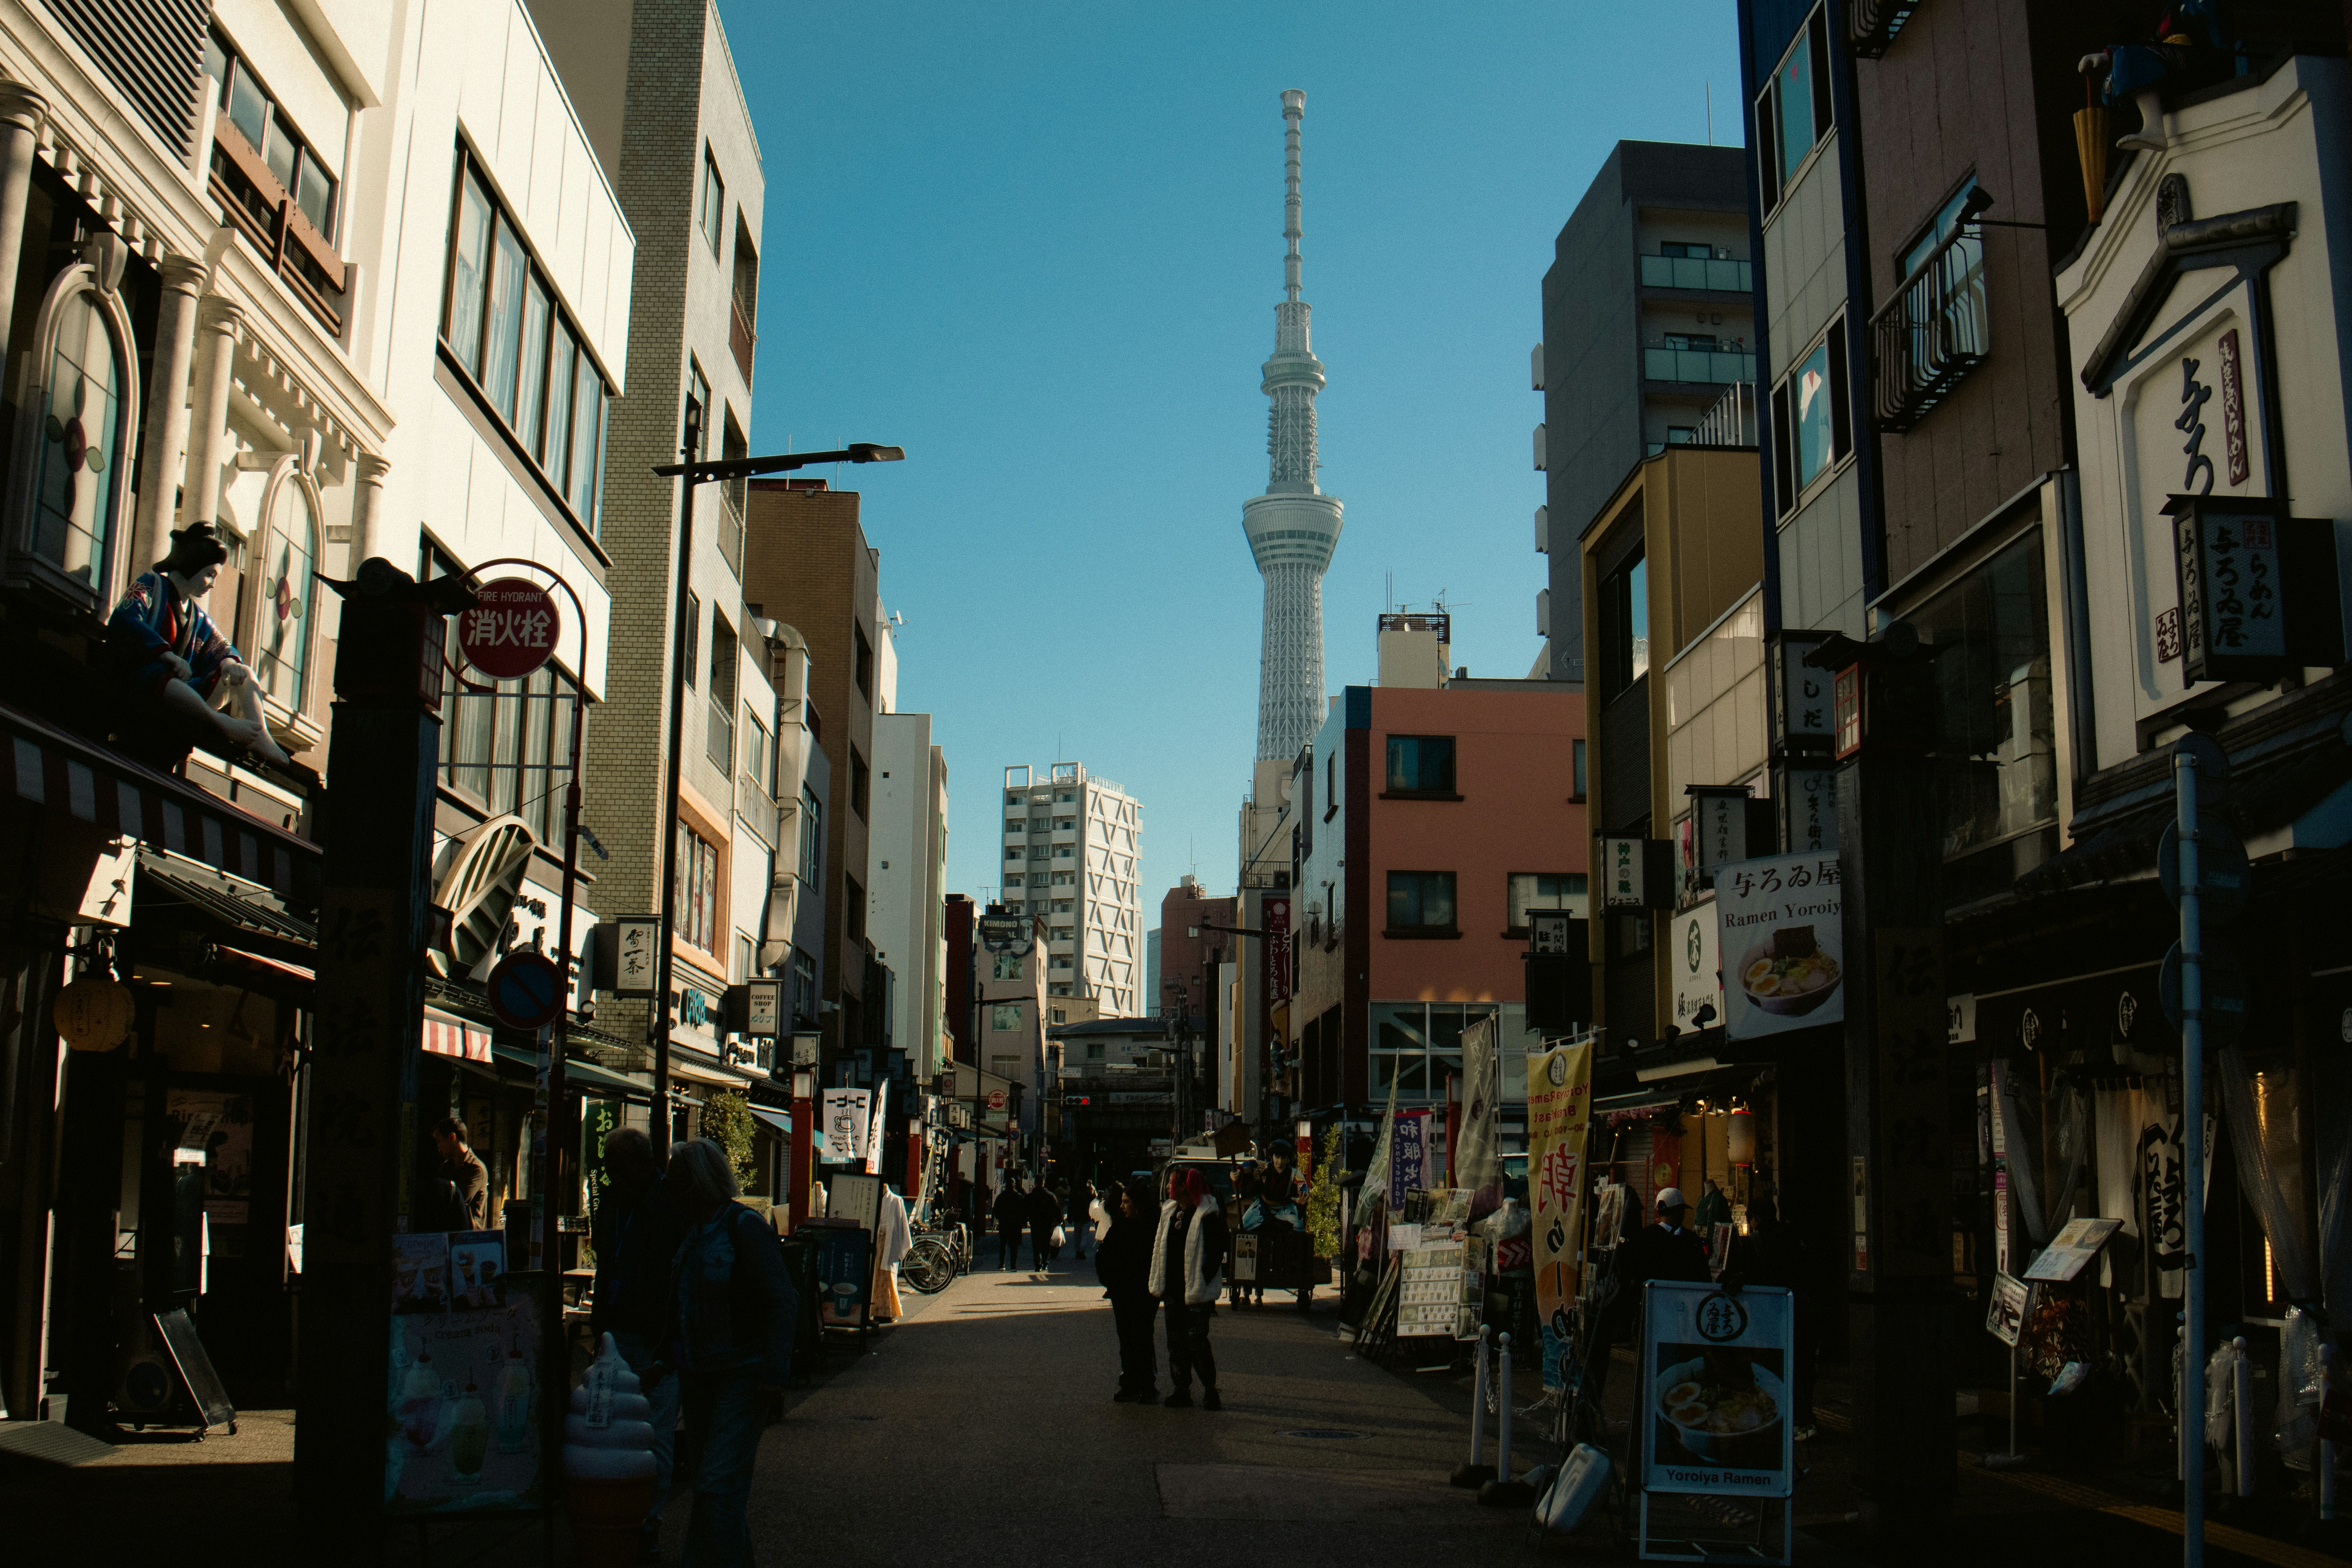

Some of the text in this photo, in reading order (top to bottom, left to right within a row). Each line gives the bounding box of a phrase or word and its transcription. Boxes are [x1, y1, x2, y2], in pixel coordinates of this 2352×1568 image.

[478, 591, 543, 603] FIRE HYDRANT
[2249, 553, 2273, 619] らめん
[466, 609, 551, 647] 消火栓
[1730, 860, 1842, 898] 与ろゐ屋
[1609, 896, 1641, 906] ヴェニス
[1724, 899, 1842, 927] Ramen Yoroiy
[589, 1169, 600, 1196] Special
[434, 1322, 501, 1339] cream soda
[1666, 1468, 1771, 1485] Yoroiya Ramen
